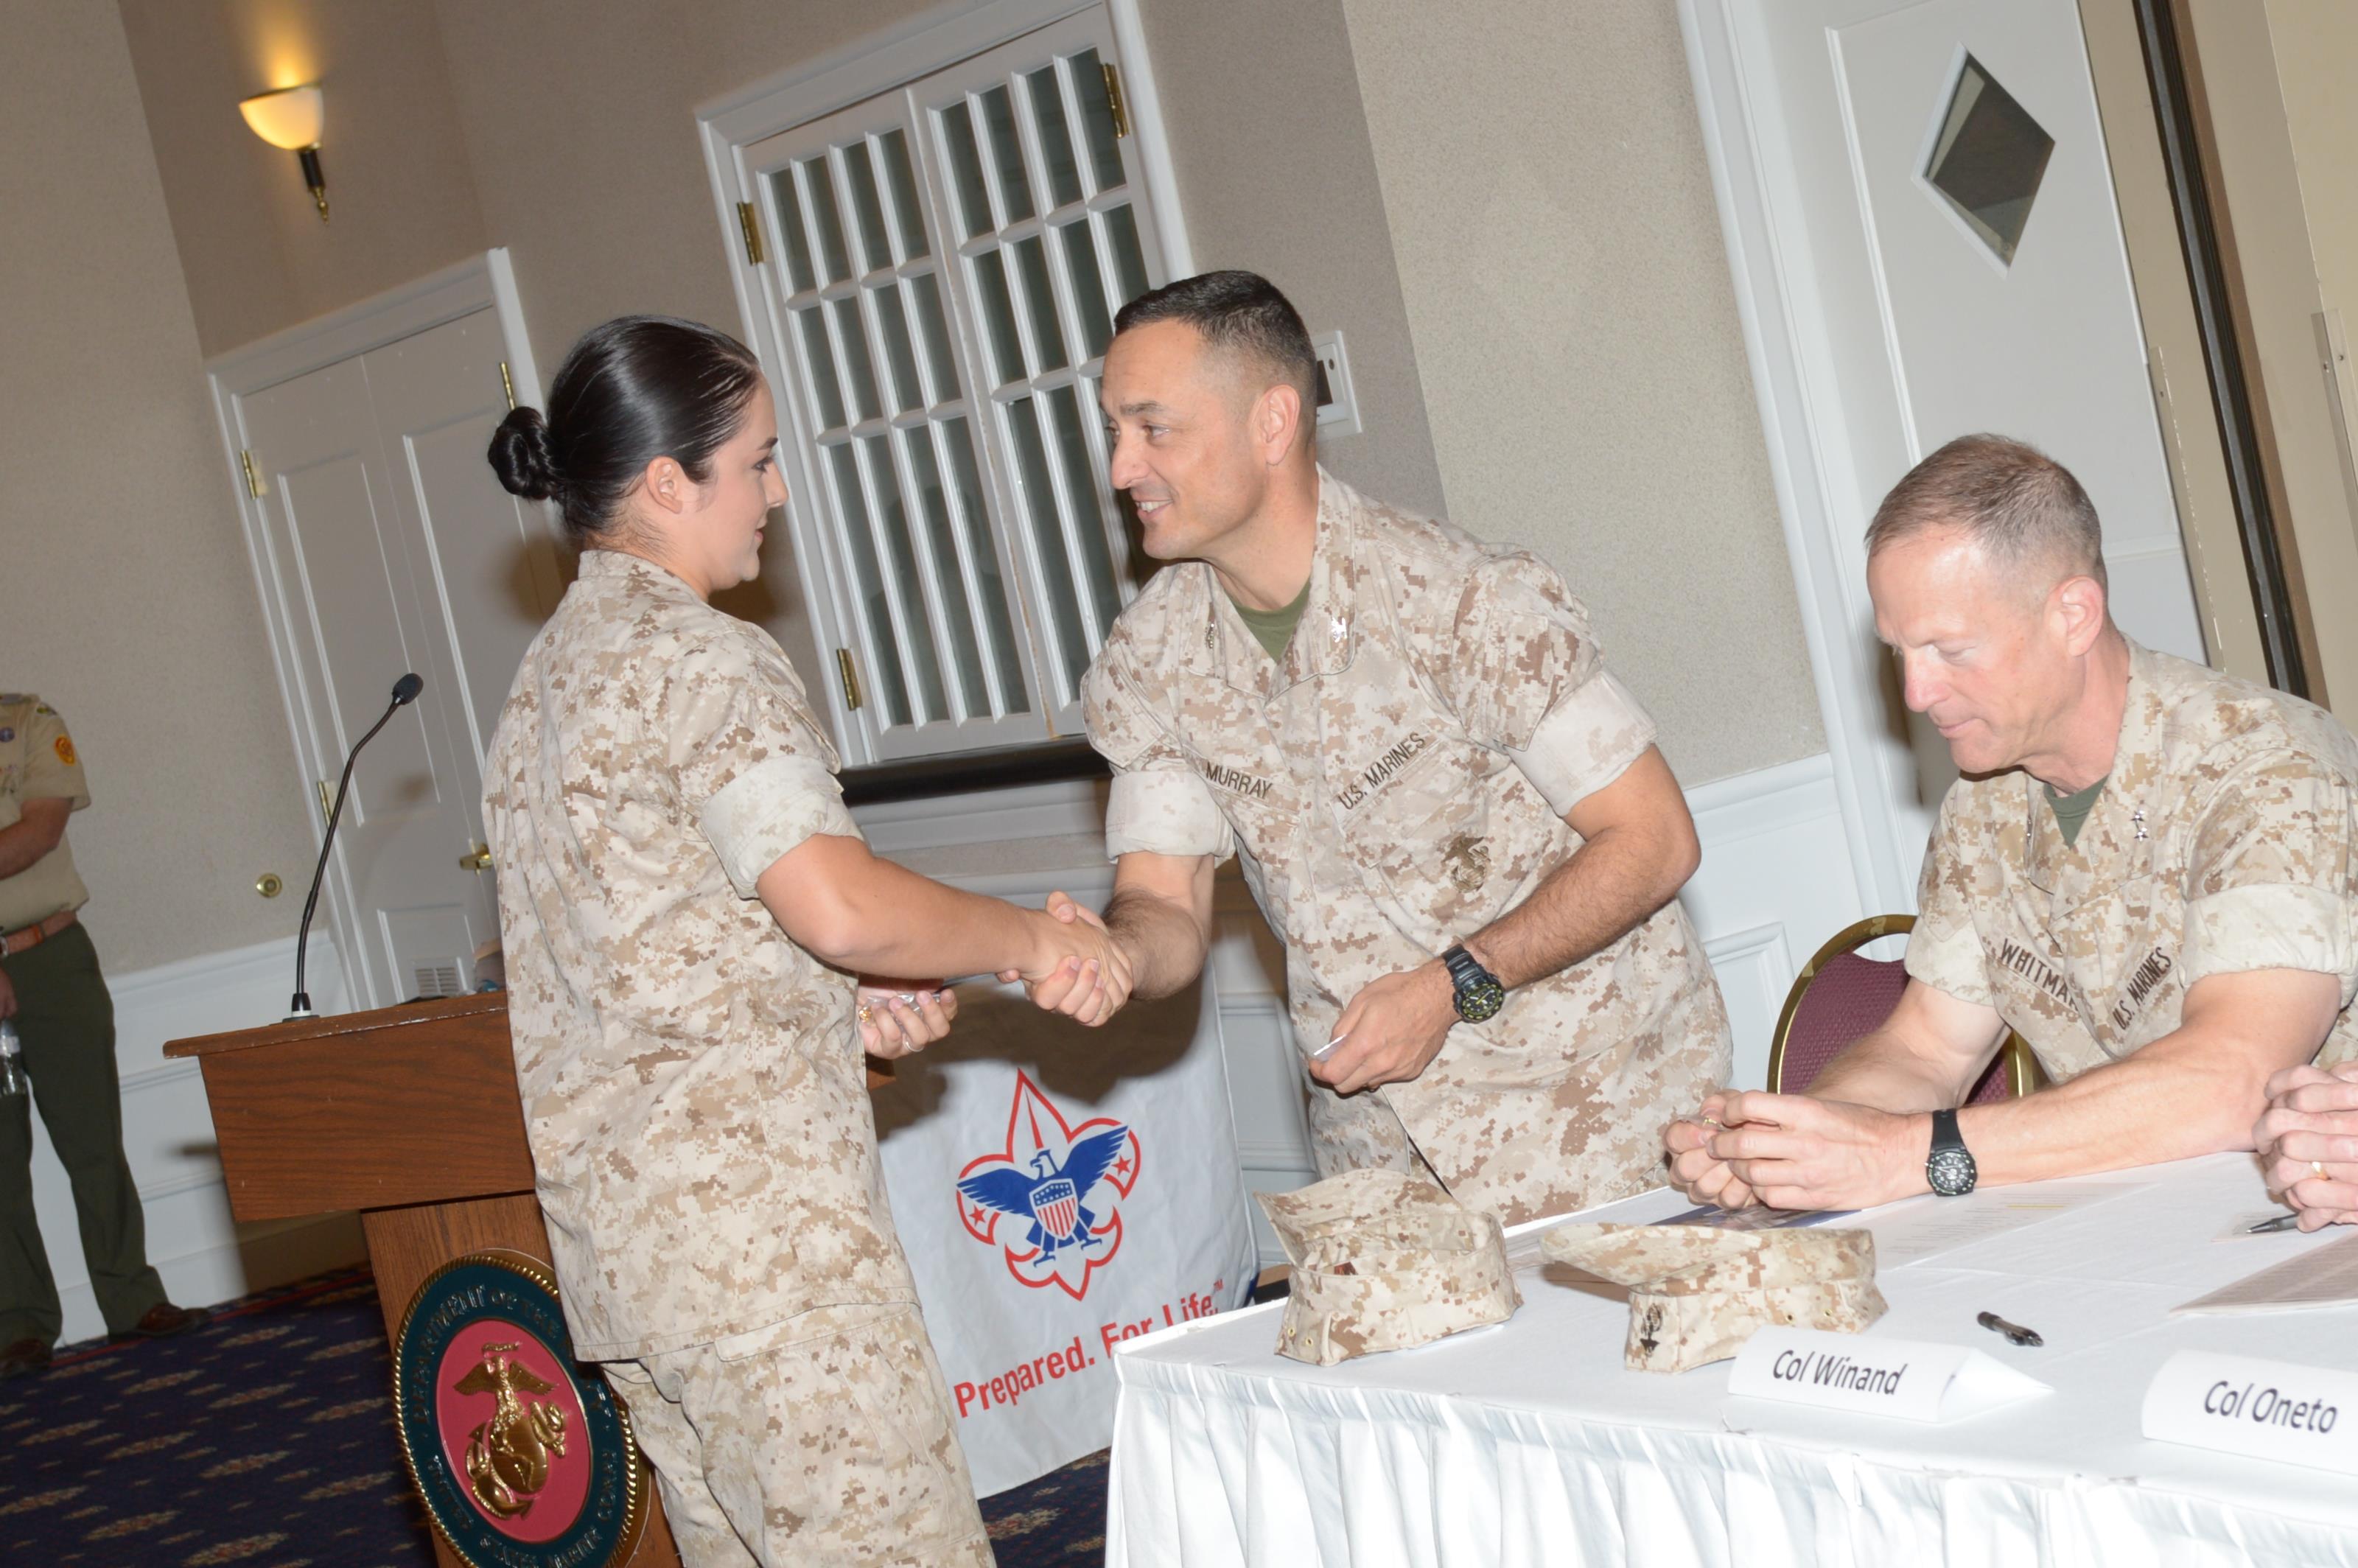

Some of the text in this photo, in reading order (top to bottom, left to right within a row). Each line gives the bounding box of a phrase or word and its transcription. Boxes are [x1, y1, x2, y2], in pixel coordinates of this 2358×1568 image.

[1206, 761, 1273, 800] MURRAY
[1337, 732, 1427, 811] U.S. MARINES
[2112, 946, 2172, 1031] U.S. MARINES
[954, 1336, 1096, 1418] Prepared.
[1772, 1350, 1909, 1396] Col Winand
[2204, 1380, 2338, 1434] Col Oneto
